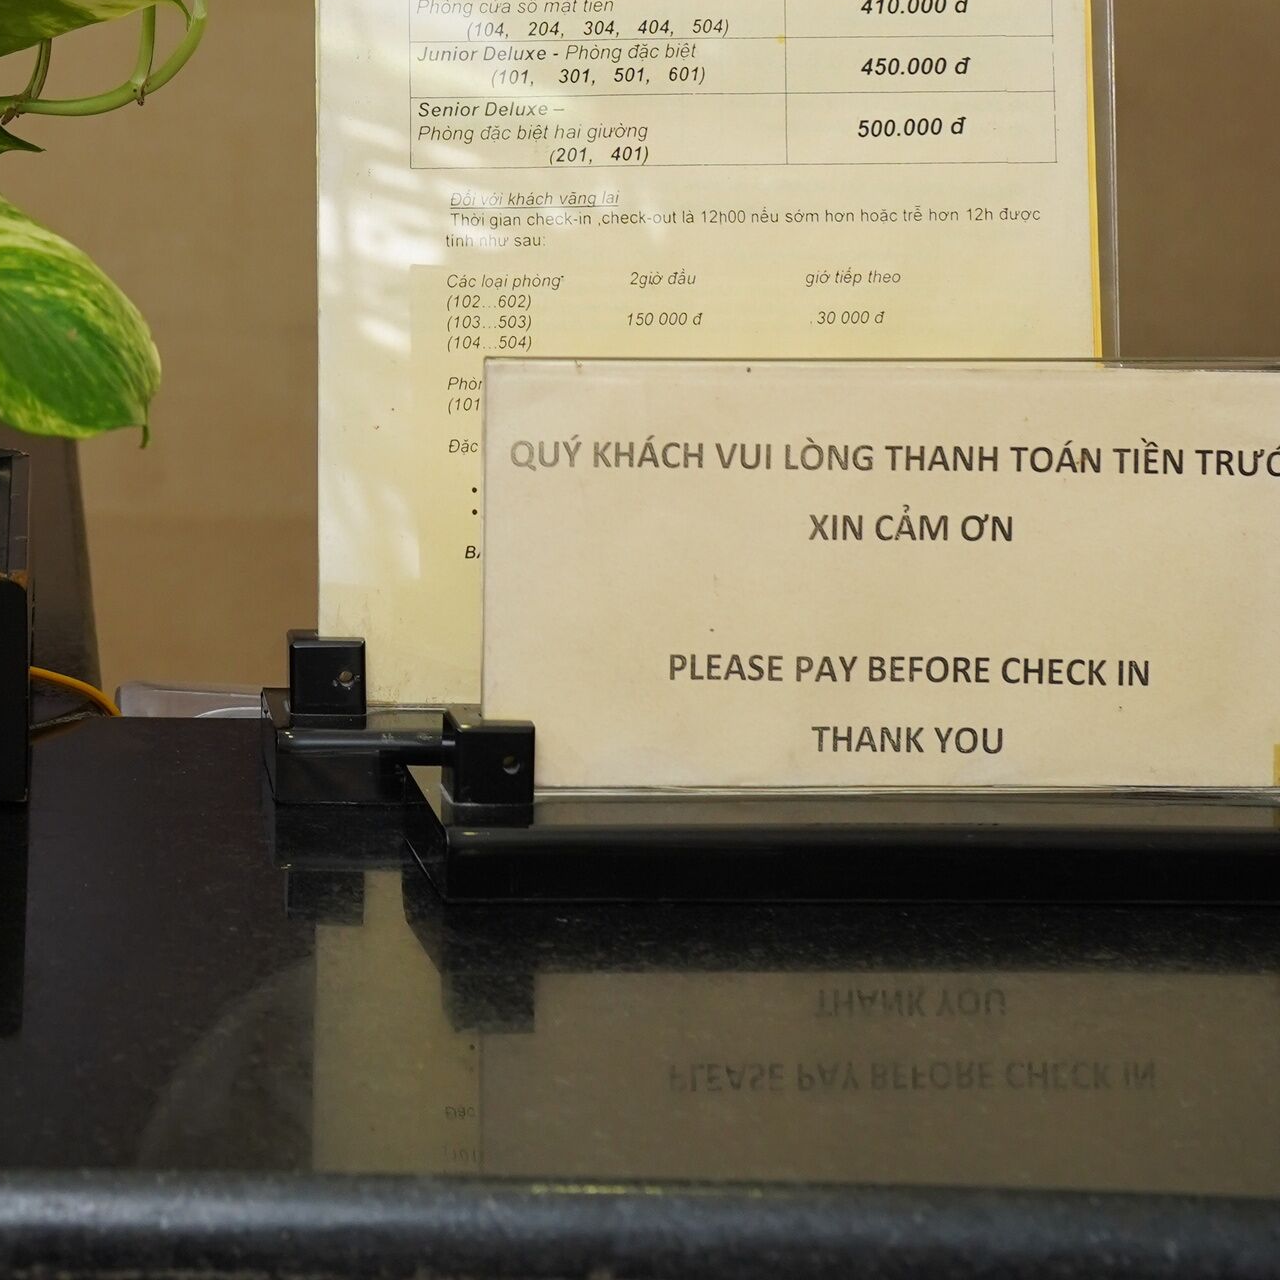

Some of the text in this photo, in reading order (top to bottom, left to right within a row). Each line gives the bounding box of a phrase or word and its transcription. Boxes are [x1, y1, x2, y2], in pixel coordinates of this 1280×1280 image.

[468, 19, 728, 41] (104, 204, 304, 404, 504)
[417, 43, 696, 63] Junior Deluxe Phòng đặc biệt
[861, 57, 971, 75] 450.000 đ
[492, 67, 705, 88] (101, 301, 501, 601)
[419, 102, 547, 117] Senior Deluxe
[418, 123, 648, 144] Phòng đặc biệt hai giường
[858, 117, 966, 137] 500.000 đ
[550, 146, 650, 166] (201, 401)
[508, 192, 552, 205] khách
[600, 190, 620, 206] lai
[450, 213, 484, 226] Thời
[490, 213, 520, 230] gian
[527, 212, 591, 226] check-in
[683, 210, 694, 223] là
[702, 210, 745, 224] 12h00
[825, 210, 854, 222] hơn
[861, 209, 897, 224] hoặc
[903, 206, 922, 221] trễ
[929, 208, 958, 221] hơn
[967, 208, 993, 221] 12h
[999, 208, 1040, 222] được
[514, 237, 545, 247] sau:
[447, 274, 476, 288] Các
[481, 274, 508, 290] loại
[668, 268, 696, 285] đầu
[835, 267, 901, 286] tiếp theo
[628, 313, 654, 326] 150
[659, 312, 687, 325] 000
[817, 311, 836, 324] 30
[841, 311, 869, 324] 000
[449, 439, 478, 455] Đặc
[511, 434, 582, 471] QUÝ
[594, 435, 703, 468] KHÁCH
[715, 443, 771, 470] VUI
[785, 437, 873, 471] LÒNG
[885, 446, 998, 472] THANH
[1010, 440, 1101, 473] TOÁN
[1113, 438, 1183, 474] TIỀN
[809, 504, 1012, 541] XIN CẢM ƠN
[465, 546, 480, 559] B
[670, 654, 1149, 686] PLEASE PAY BEFORE CHECK IN
[812, 726, 1003, 754] THANK YOU
